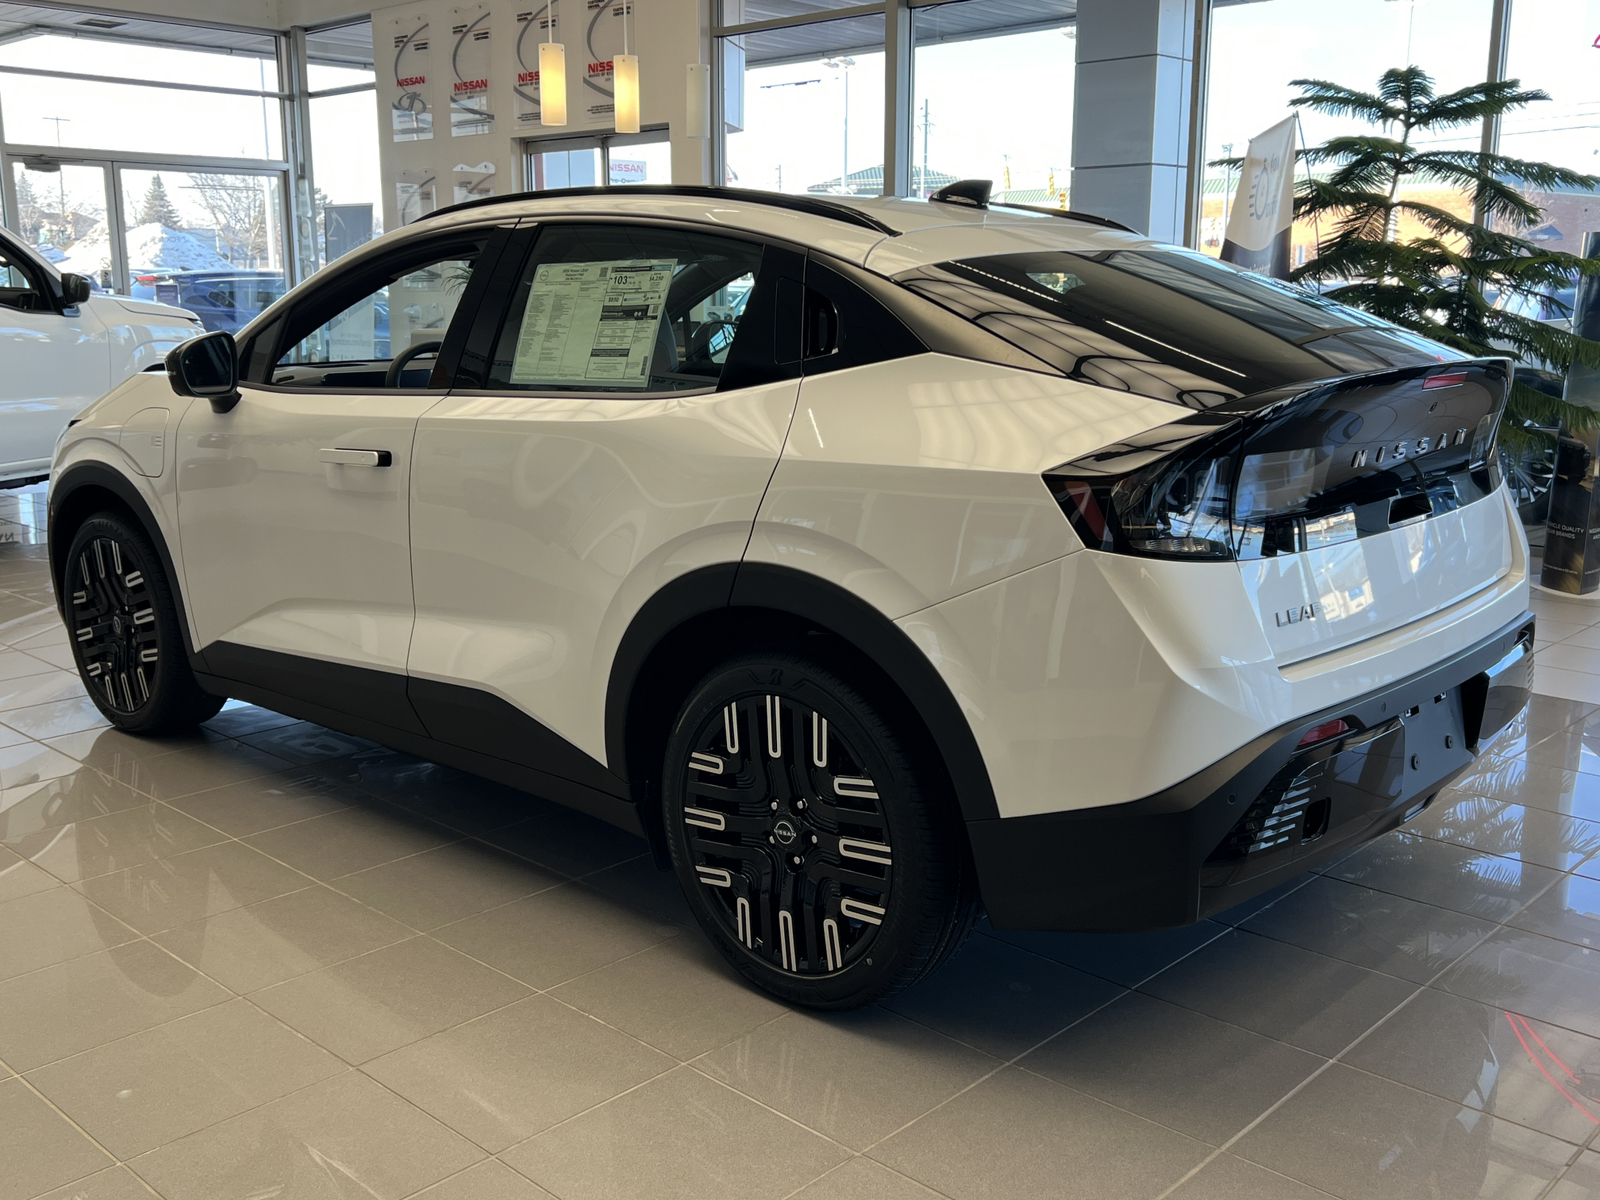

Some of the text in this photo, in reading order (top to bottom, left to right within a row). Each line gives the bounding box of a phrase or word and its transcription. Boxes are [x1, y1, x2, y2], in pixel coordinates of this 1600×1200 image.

[588, 61, 613, 74] NISS
[396, 76, 426, 88] NISSAN
[518, 71, 539, 83] NISS
[453, 79, 488, 92] NISSAN
[610, 163, 644, 173] NISSAN
[613, 275, 628, 285] 103
[1351, 428, 1467, 468] NISSAN
[1561, 524, 1585, 533] QUALITY
[1275, 601, 1321, 628] LEAF
